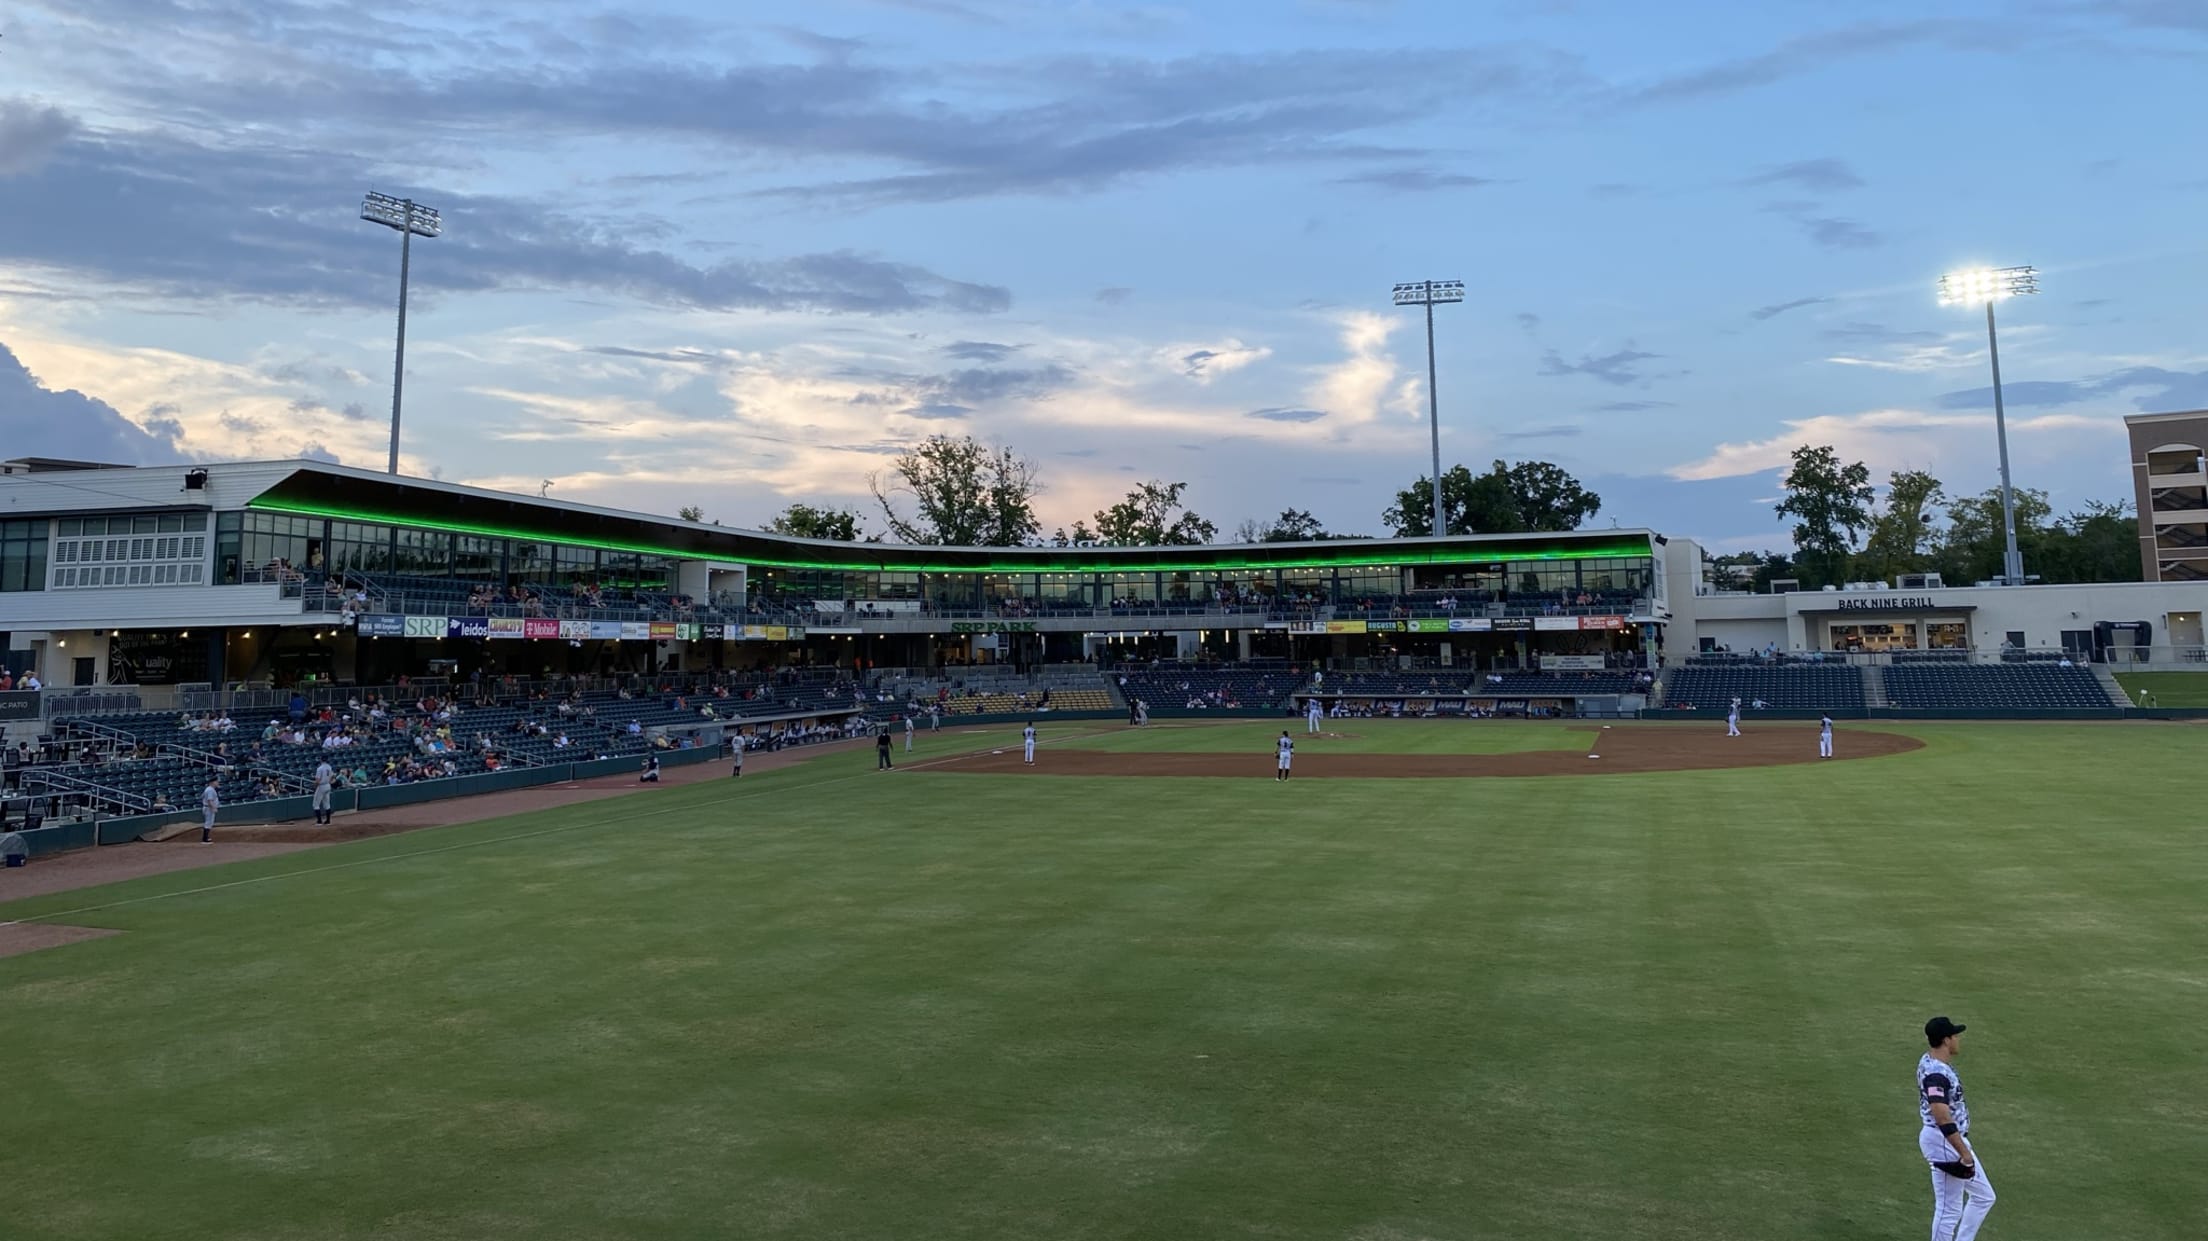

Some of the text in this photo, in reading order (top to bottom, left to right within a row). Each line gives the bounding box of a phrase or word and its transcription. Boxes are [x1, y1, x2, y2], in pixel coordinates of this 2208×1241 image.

[1838, 597, 1935, 609] BACK NINE GRILL
[406, 617, 447, 636] SRP
[461, 622, 488, 637] leidos
[951, 621, 1037, 632] SRP PARK
[8, 701, 28, 709] PATIO
